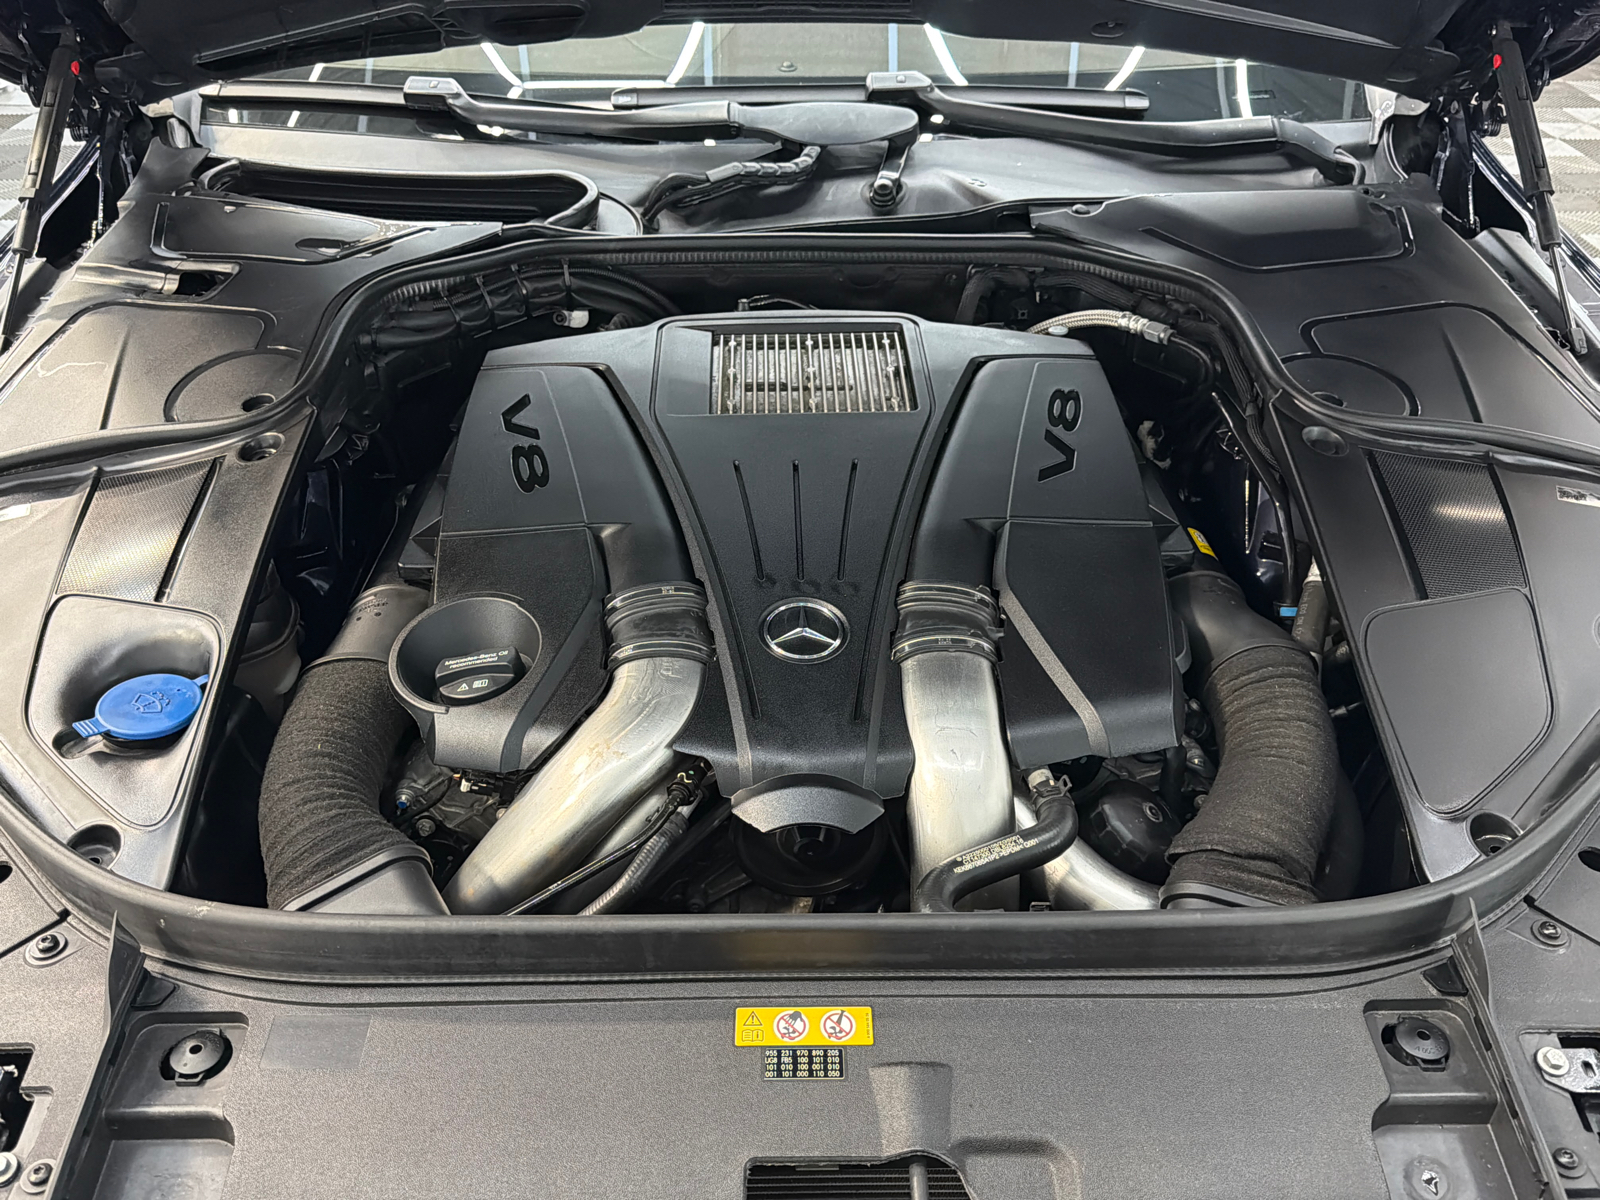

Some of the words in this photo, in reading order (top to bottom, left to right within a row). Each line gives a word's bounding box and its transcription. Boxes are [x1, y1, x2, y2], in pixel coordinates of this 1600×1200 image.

[501, 392, 550, 494] V8
[1037, 388, 1082, 483] V8
[445, 652, 497, 666] Mercedes-Benz
[449, 657, 498, 669] recommended
